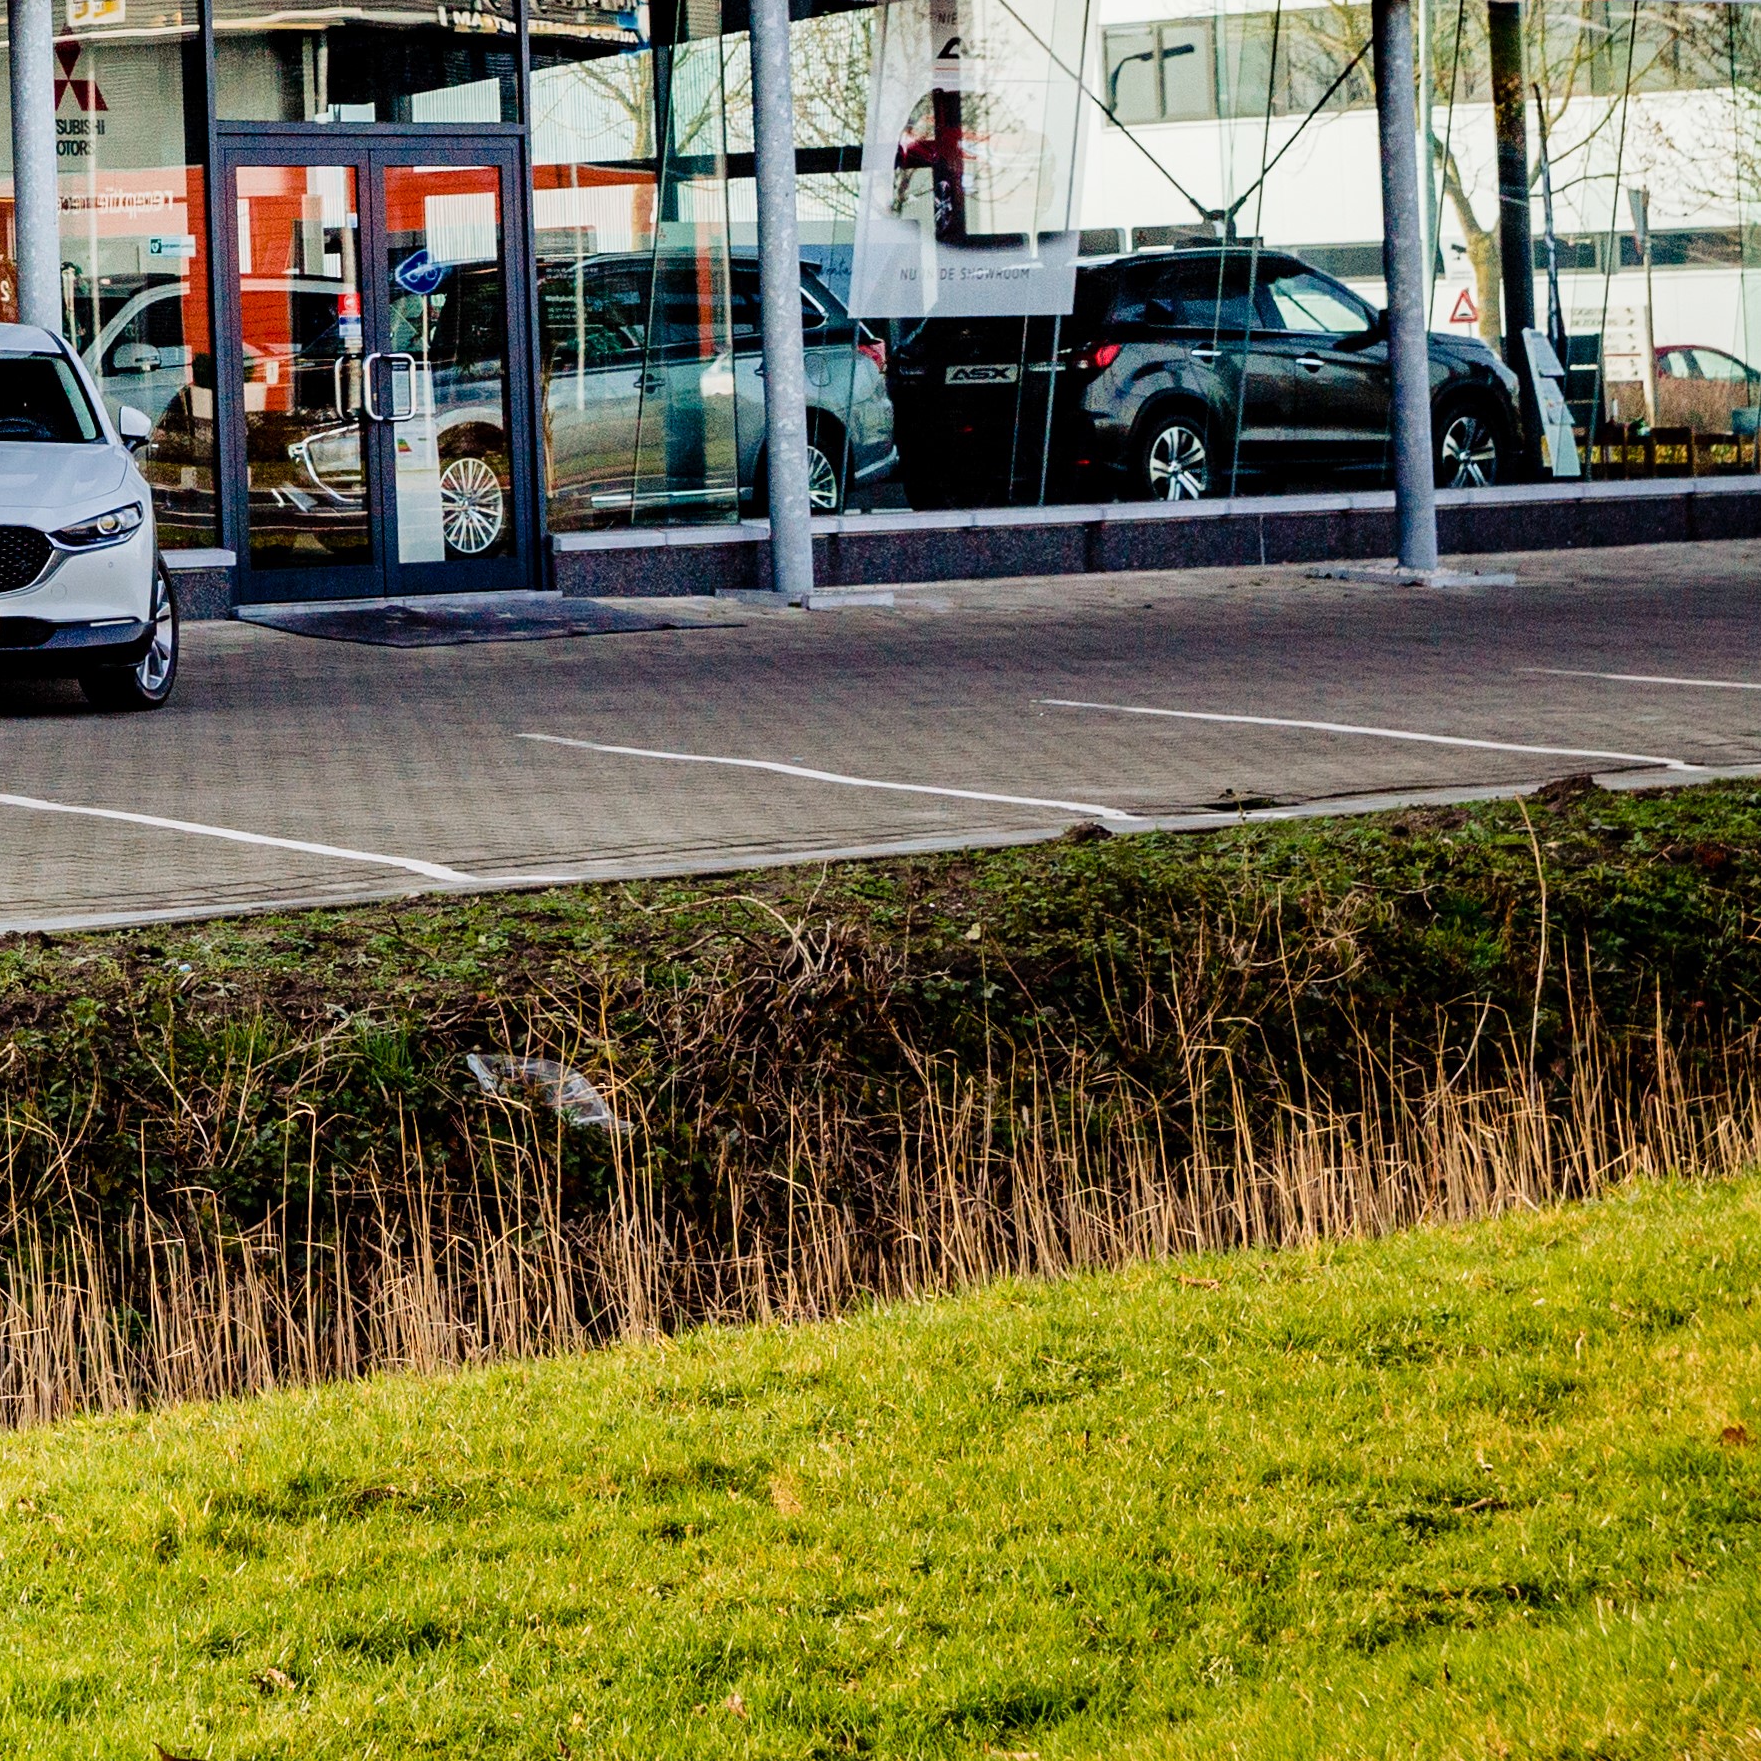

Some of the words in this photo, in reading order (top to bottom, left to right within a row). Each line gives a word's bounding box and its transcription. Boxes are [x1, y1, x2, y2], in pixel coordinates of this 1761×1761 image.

[54, 118, 106, 136] SUBISHI
[55, 139, 96, 156] OTORS
[939, 267, 956, 281] DE
[951, 366, 1011, 380] ASX
